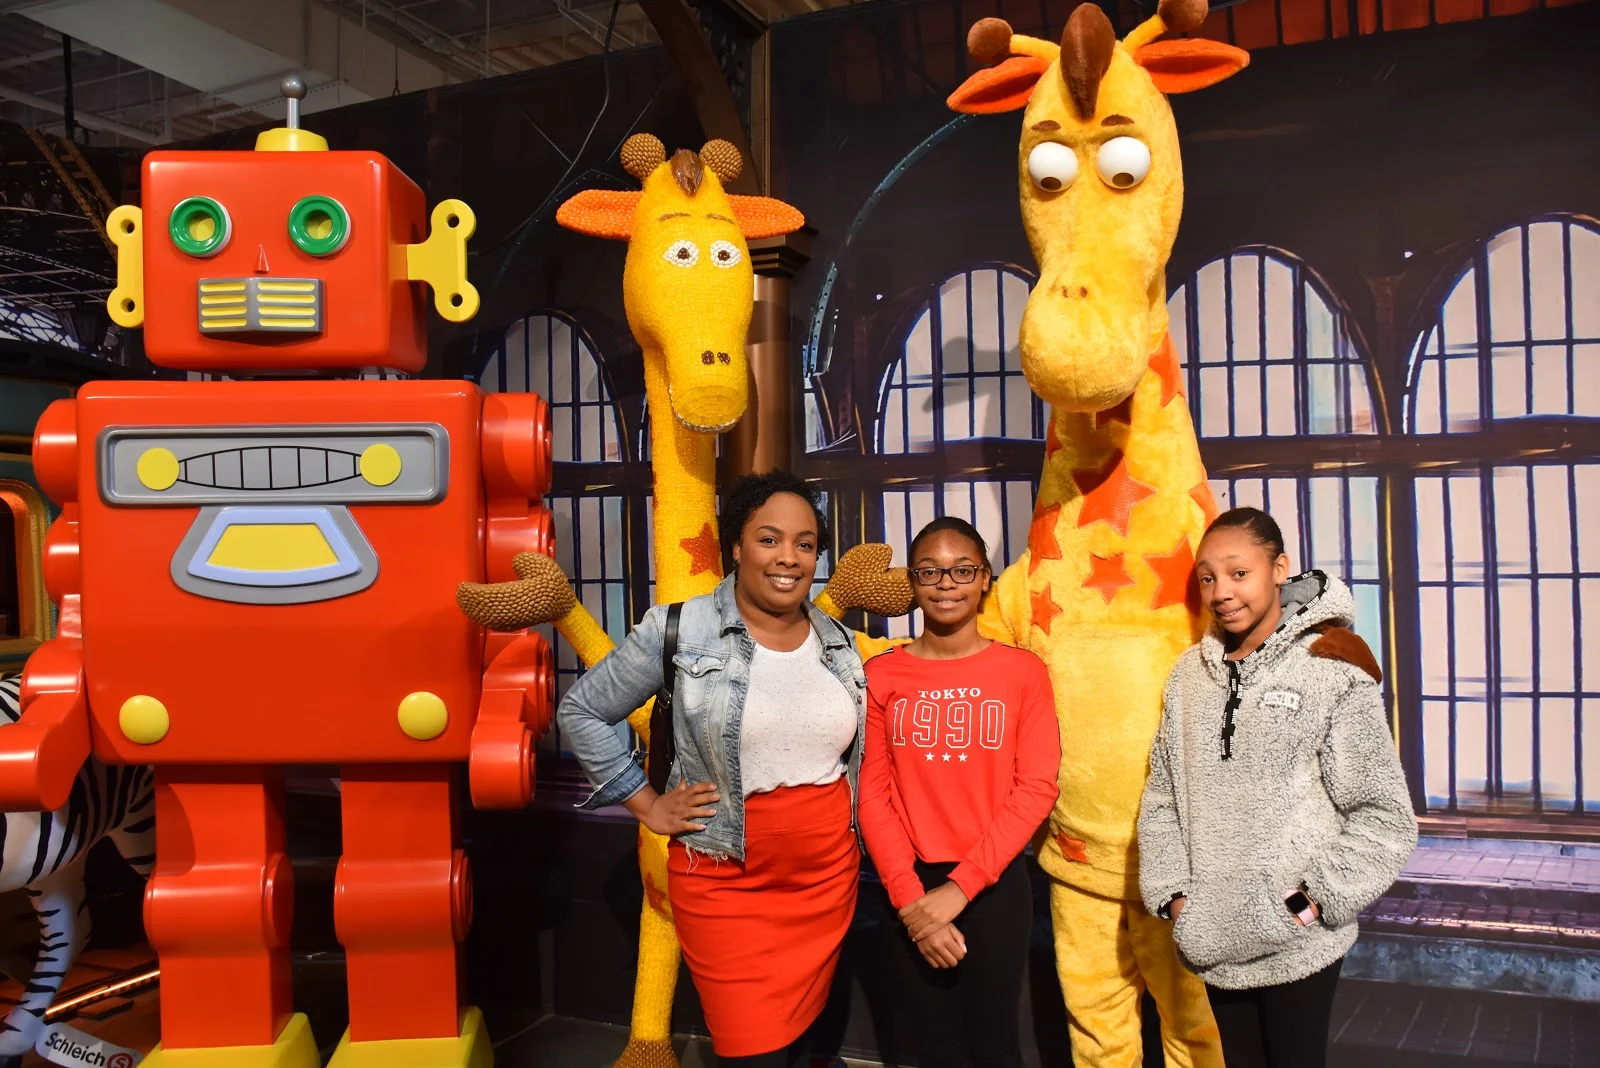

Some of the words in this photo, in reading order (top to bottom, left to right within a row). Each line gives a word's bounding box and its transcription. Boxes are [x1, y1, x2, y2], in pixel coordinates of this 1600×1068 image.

[918, 687, 981, 700] TOKYO
[893, 699, 1005, 749] 1990
[45, 1031, 106, 1067] Schleich
